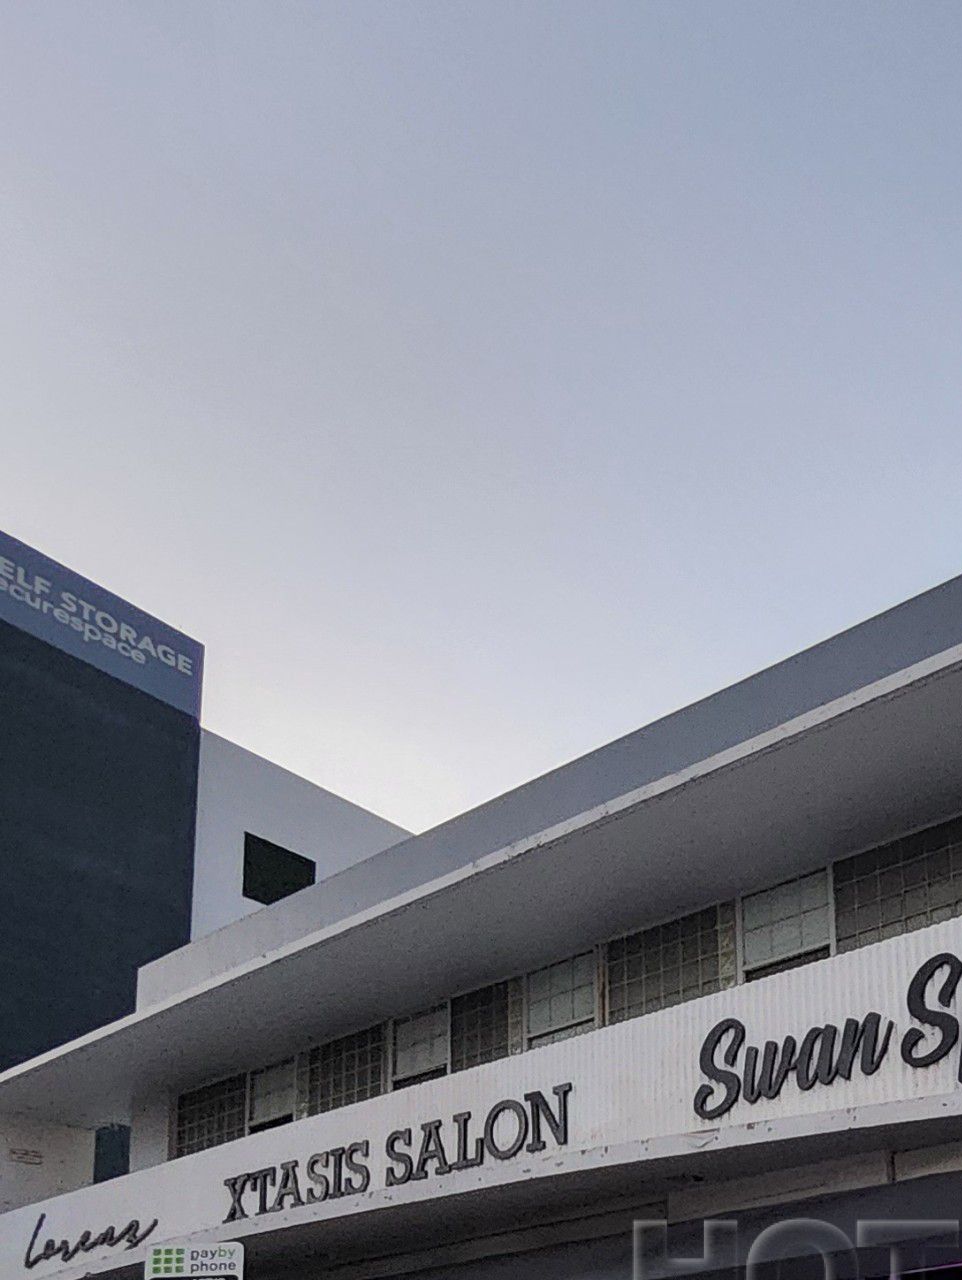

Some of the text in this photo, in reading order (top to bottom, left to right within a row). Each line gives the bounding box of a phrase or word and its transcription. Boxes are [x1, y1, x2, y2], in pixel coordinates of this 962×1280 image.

[60, 591, 194, 677] STORAGE
[693, 1011, 894, 1120] Swan
[222, 1081, 573, 1225] XTASIS SALON
[190, 1261, 237, 1274] phone
